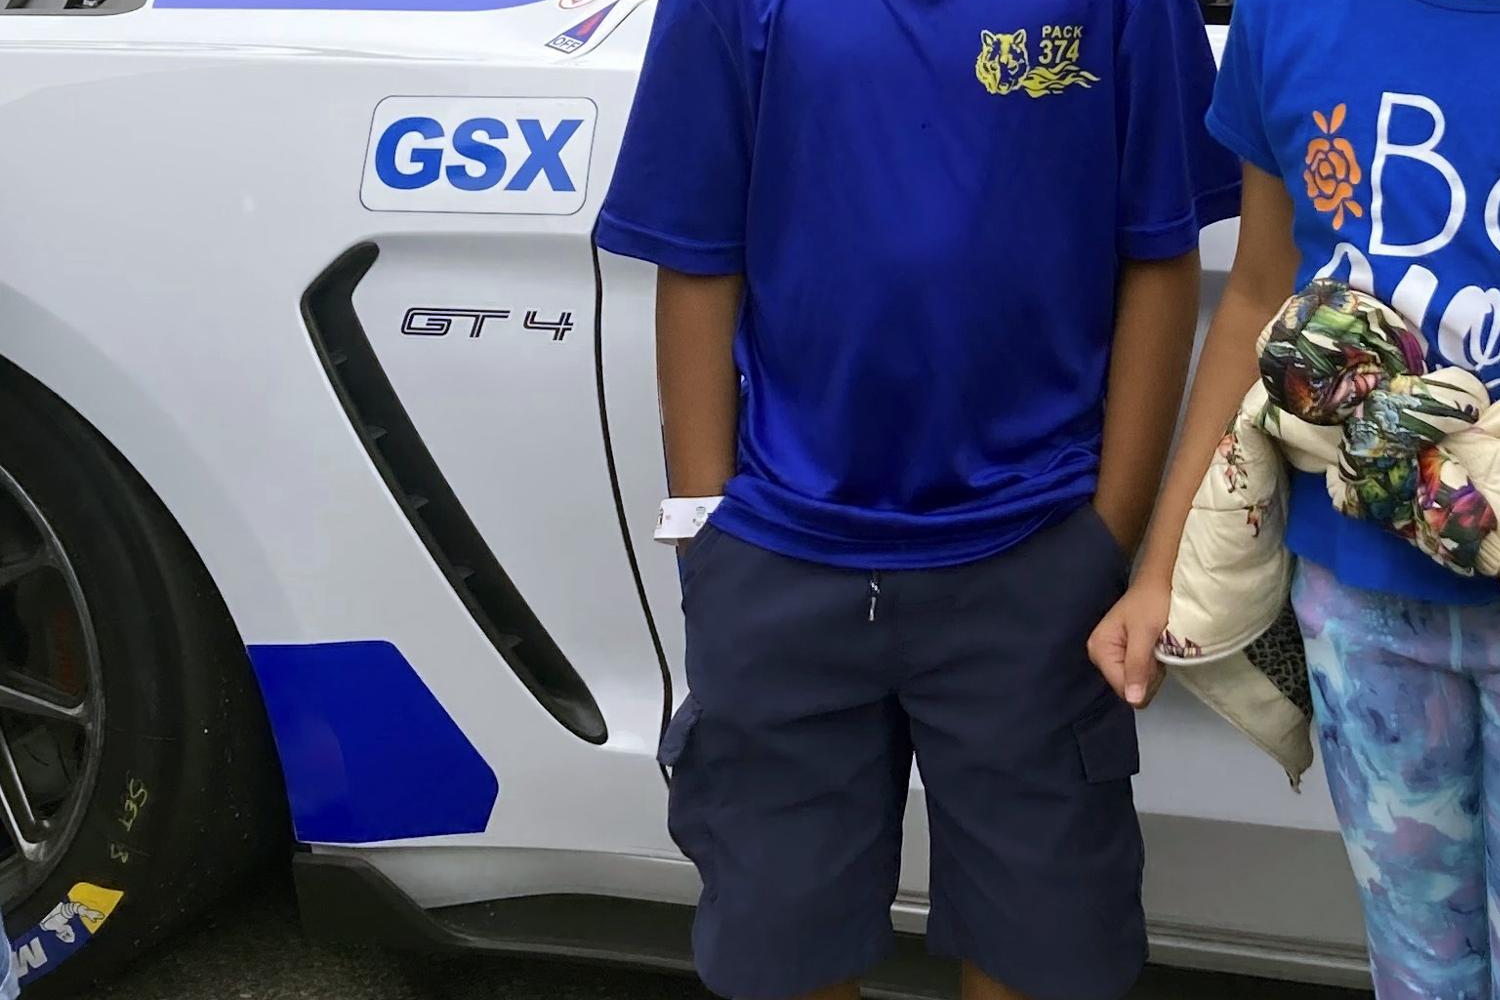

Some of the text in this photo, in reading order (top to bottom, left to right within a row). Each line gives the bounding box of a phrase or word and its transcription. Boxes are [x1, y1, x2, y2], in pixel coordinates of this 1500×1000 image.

[552, 35, 582, 51] OFF
[1042, 25, 1083, 39] PACK
[1038, 39, 1081, 64] 374
[374, 116, 584, 192] GSX
[400, 307, 575, 342] GT 4
